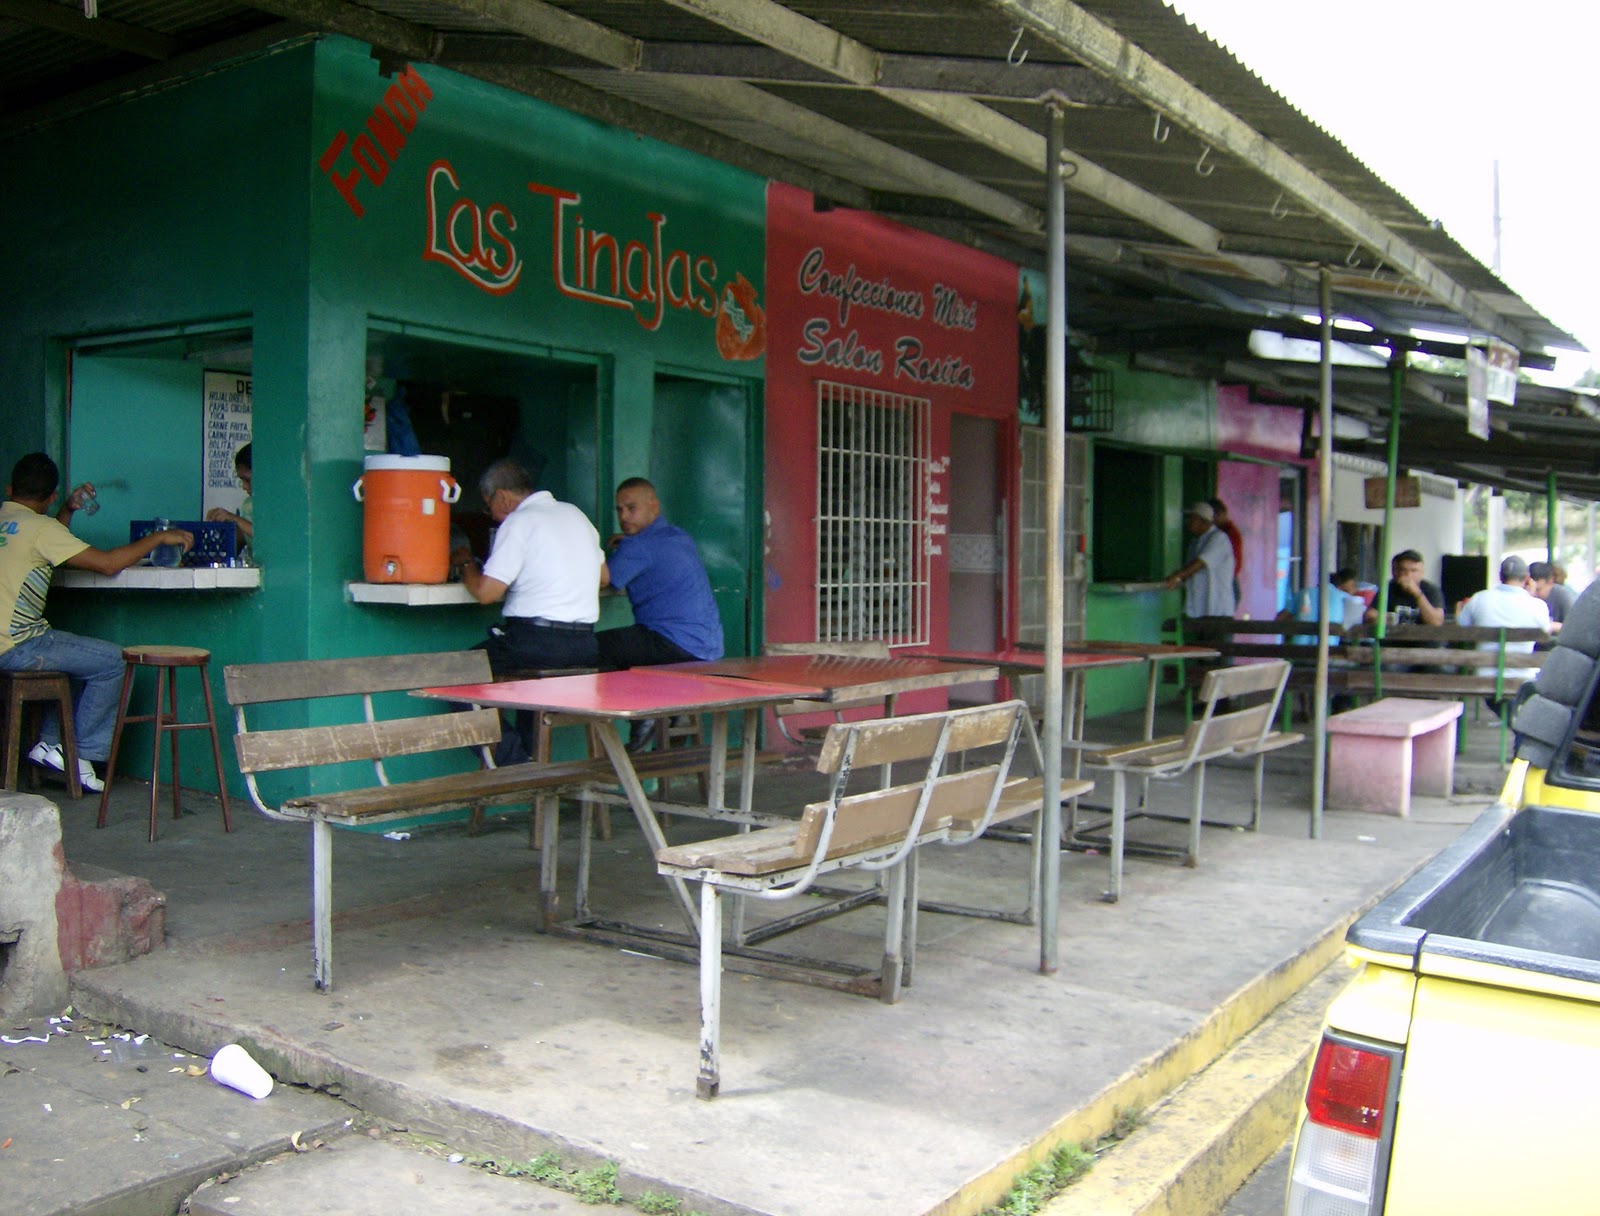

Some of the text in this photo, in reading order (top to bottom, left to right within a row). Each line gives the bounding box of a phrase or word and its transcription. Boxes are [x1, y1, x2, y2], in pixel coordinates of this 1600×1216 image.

[319, 64, 434, 219] FONDA
[422, 159, 523, 296] Las
[799, 247, 925, 328] Confecciones
[797, 317, 975, 390] Salon Rosita
[208, 421, 228, 431] CARNE
[209, 402, 229, 413] PAPAS
[208, 431, 227, 440] CARNE
[208, 450, 229, 459] CARNE
